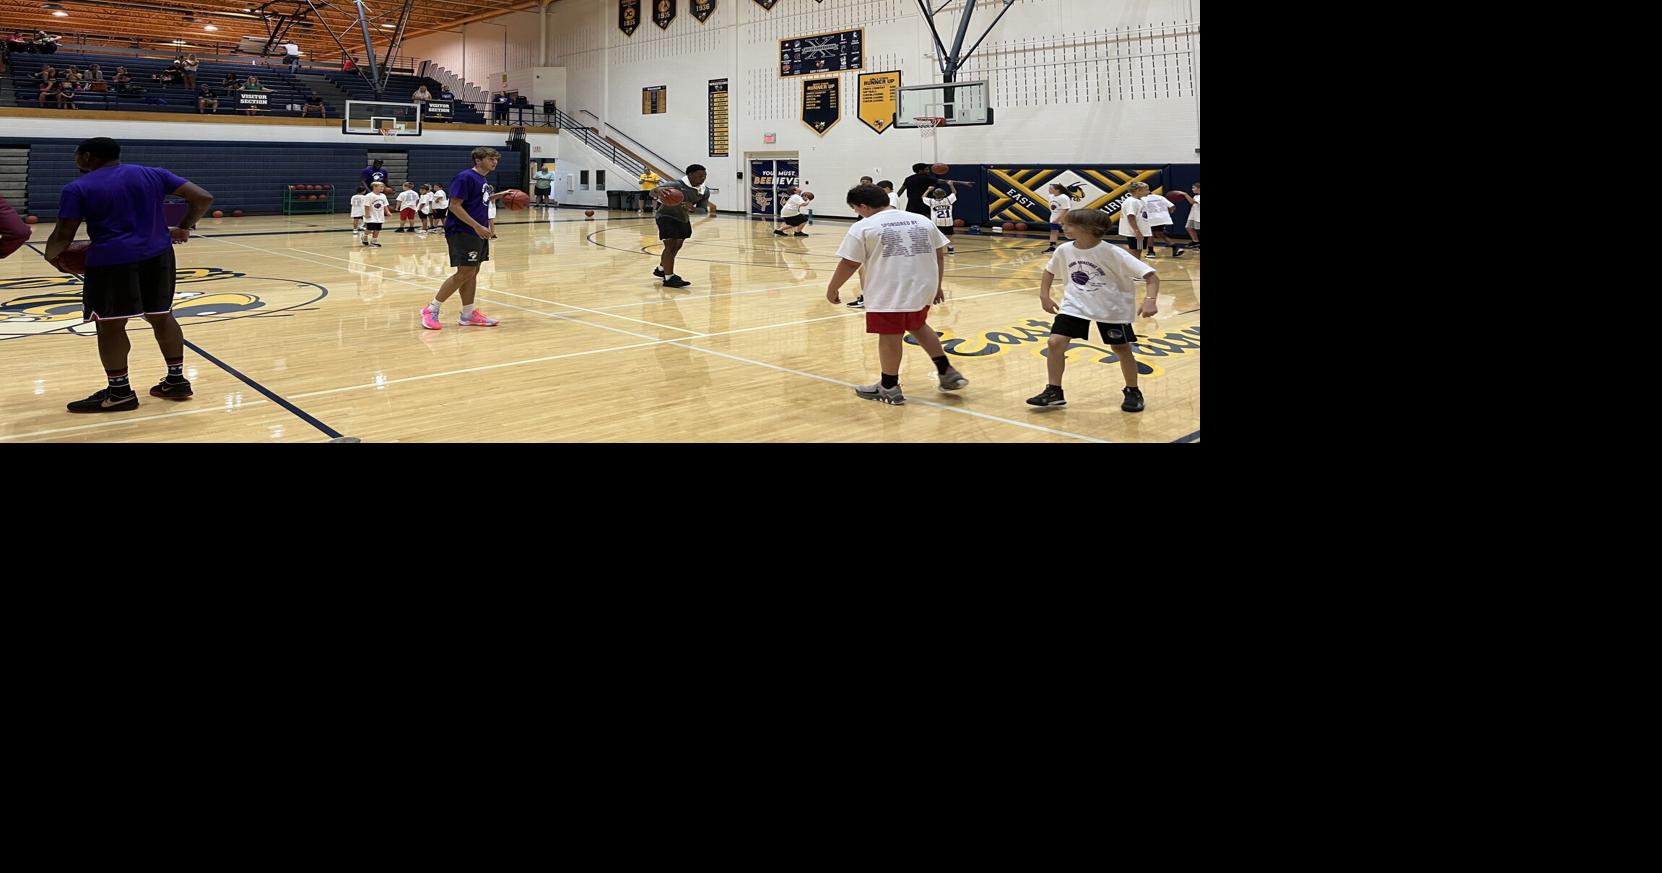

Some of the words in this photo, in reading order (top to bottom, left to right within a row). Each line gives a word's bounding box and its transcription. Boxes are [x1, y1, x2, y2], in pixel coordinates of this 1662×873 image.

[754, 176, 800, 185] BEEIEVE
[1006, 187, 1036, 209] EAST
[936, 210, 950, 218] 21
